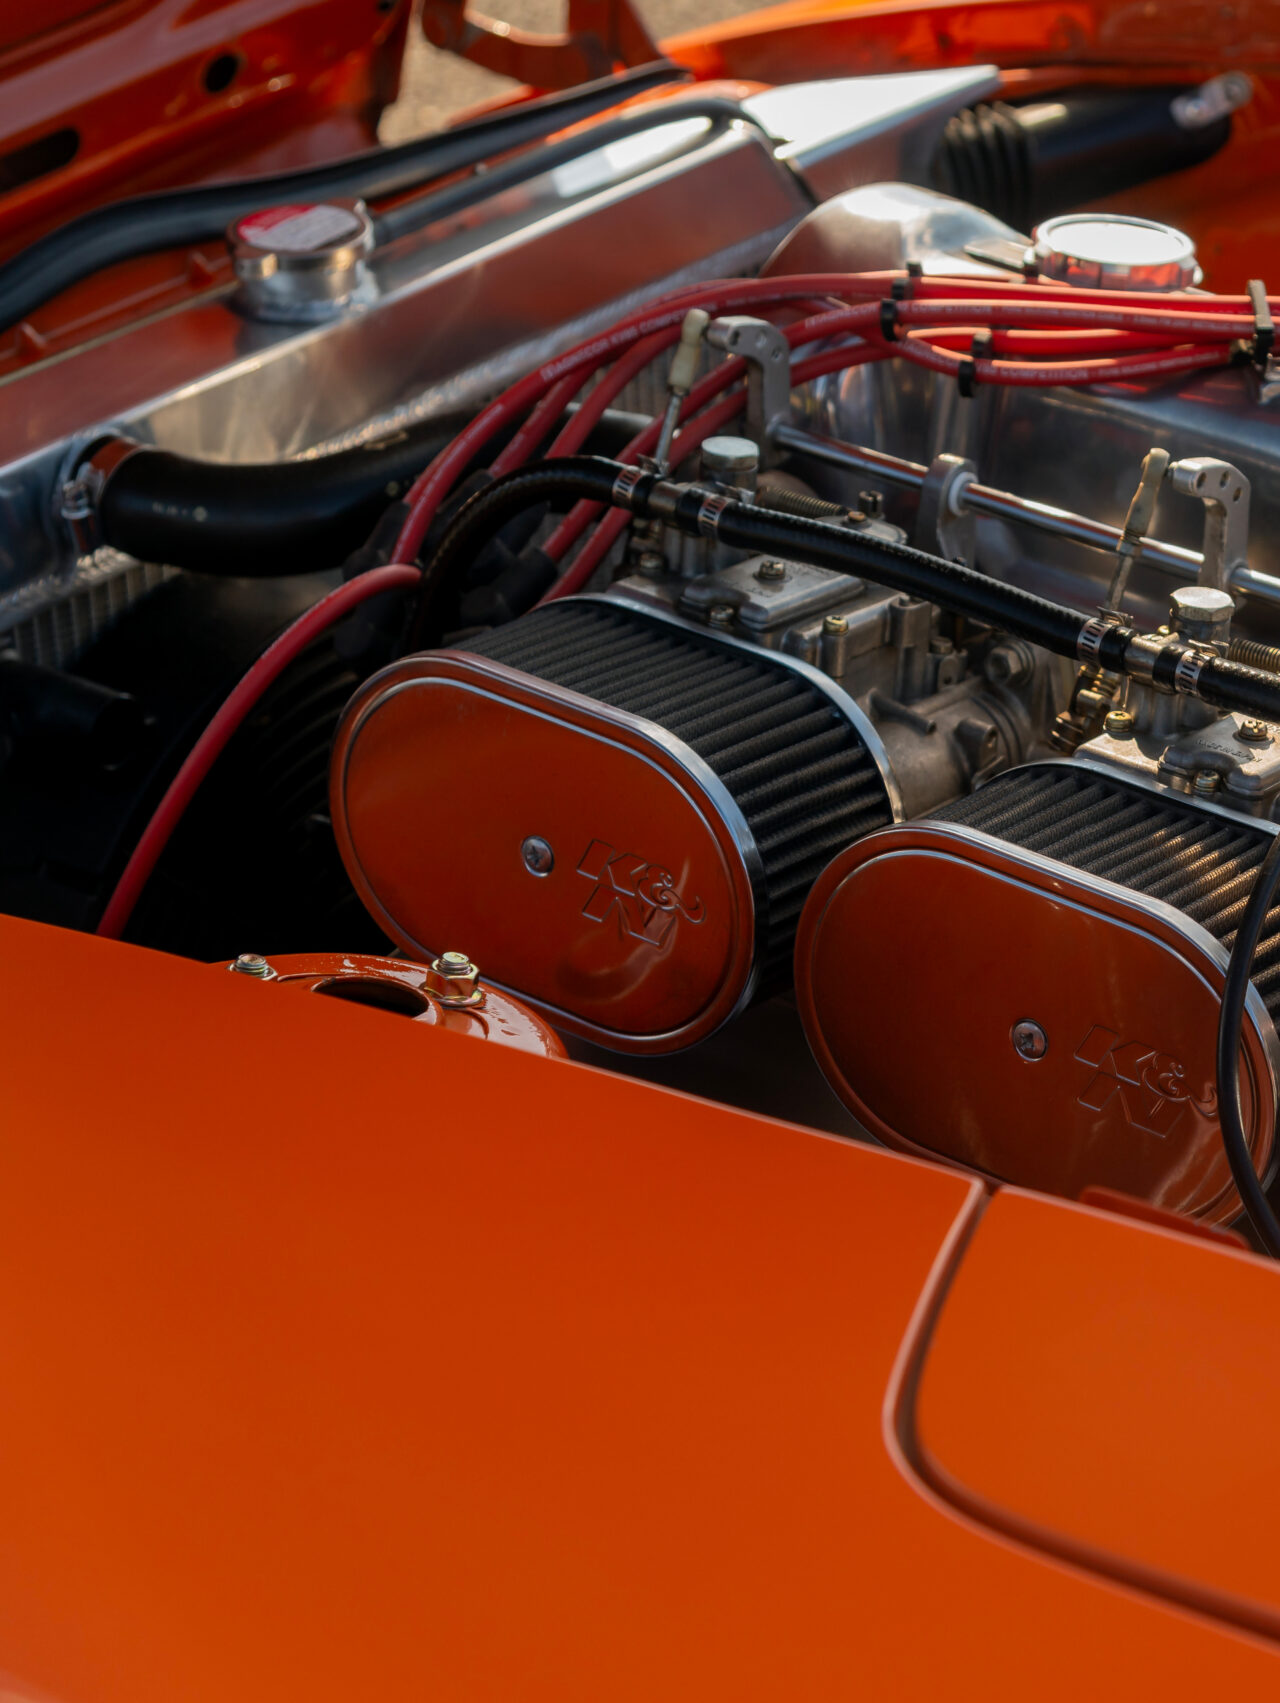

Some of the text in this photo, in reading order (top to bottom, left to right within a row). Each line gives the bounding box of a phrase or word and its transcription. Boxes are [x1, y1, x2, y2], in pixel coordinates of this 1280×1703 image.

[805, 304, 878, 329] MAGNECOR
[576, 838, 706, 947] K&N
[1074, 1024, 1218, 1138] K&N
